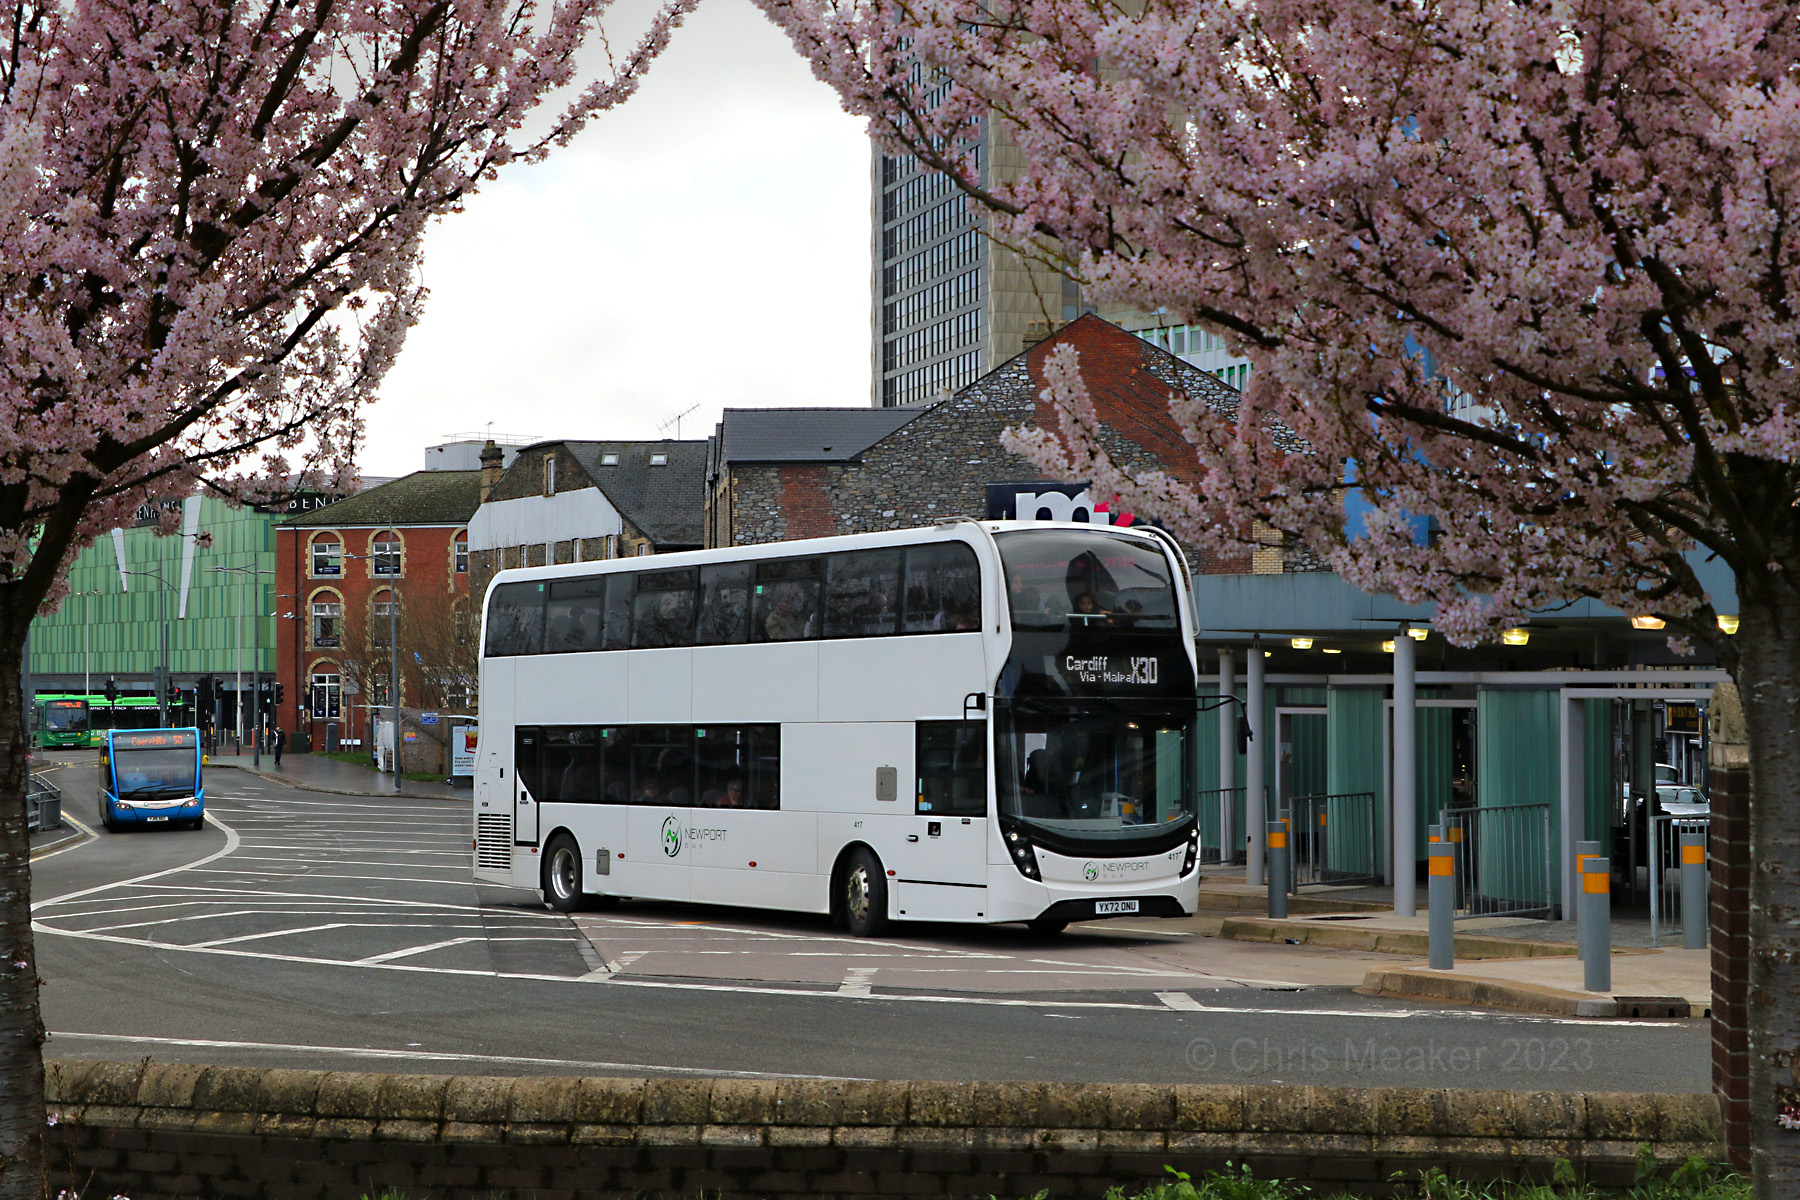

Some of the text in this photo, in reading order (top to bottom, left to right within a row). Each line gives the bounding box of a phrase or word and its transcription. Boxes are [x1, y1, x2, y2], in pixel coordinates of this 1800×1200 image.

[1066, 655, 1158, 684] Cardiff X30
[1080, 671, 1096, 682] Via
[131, 735, 183, 745] Caerphilly 50
[684, 829, 728, 841] NEWPORT
[685, 842, 703, 850] bus
[1168, 852, 1179, 860] 417
[1102, 861, 1150, 872] NEWPORT
[1099, 902, 1136, 912] YX72 ONU
